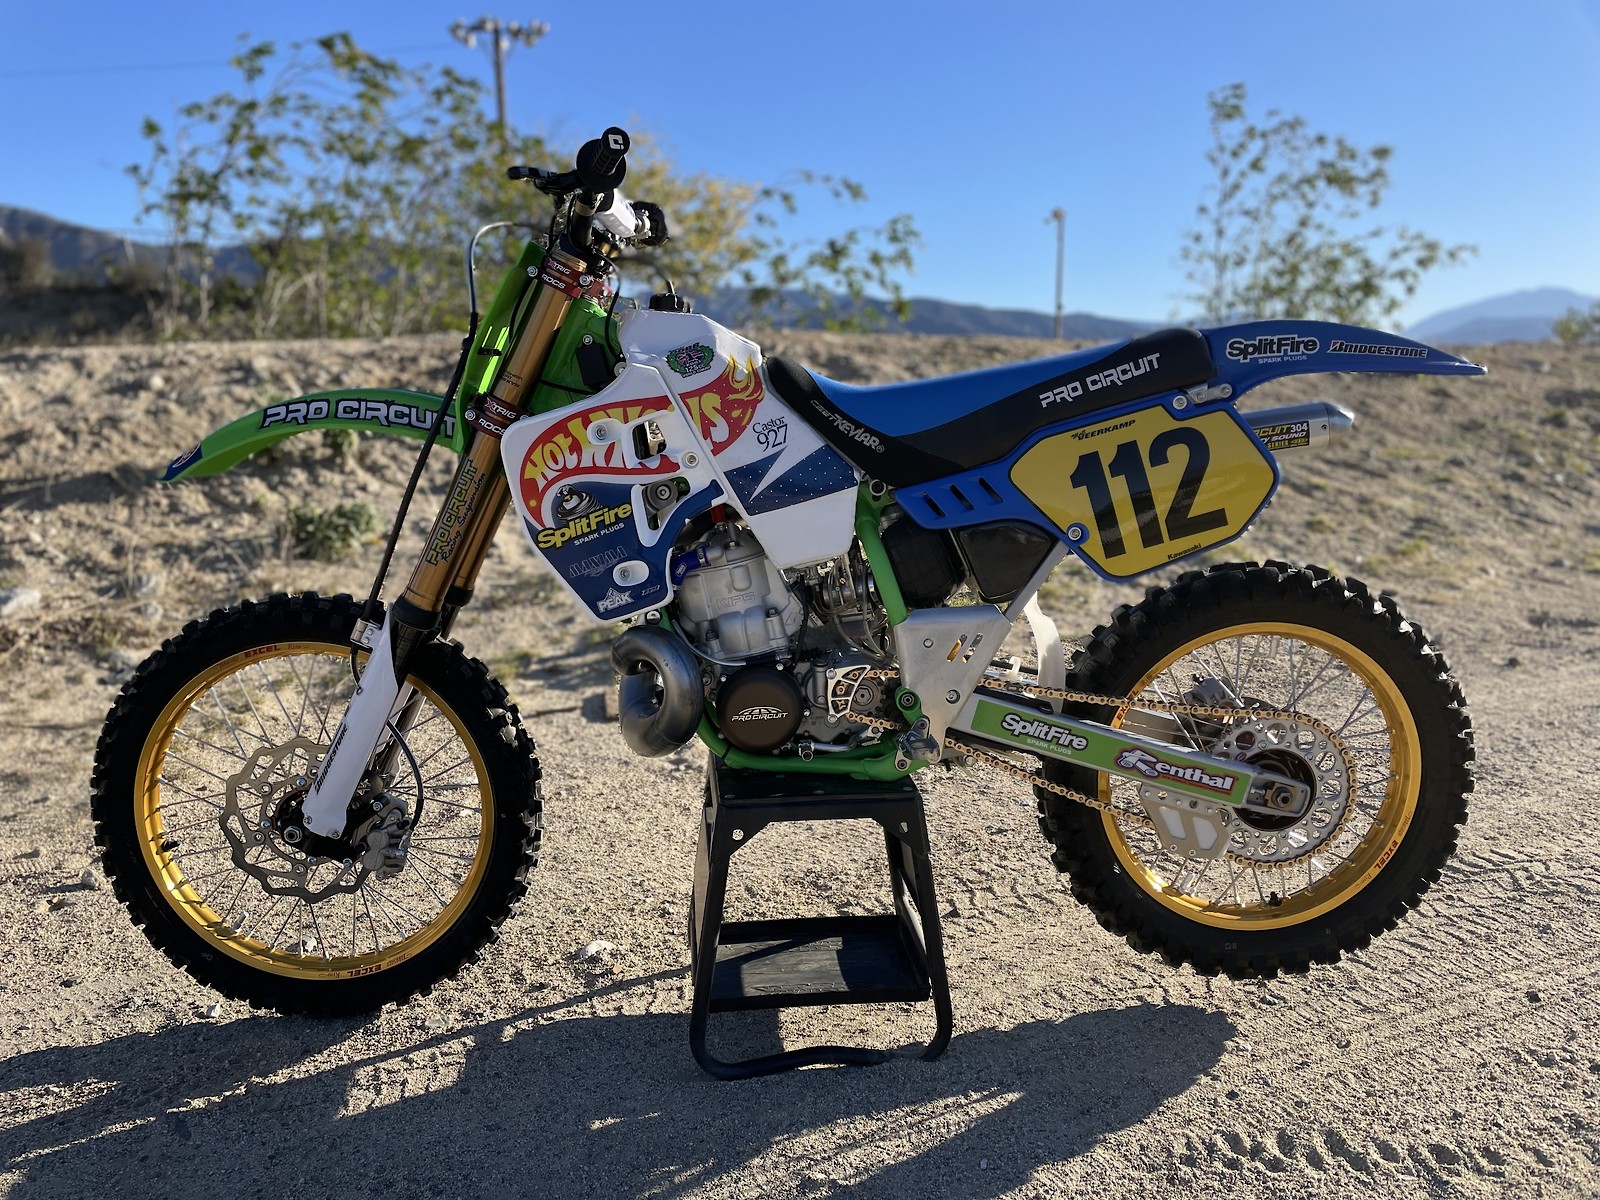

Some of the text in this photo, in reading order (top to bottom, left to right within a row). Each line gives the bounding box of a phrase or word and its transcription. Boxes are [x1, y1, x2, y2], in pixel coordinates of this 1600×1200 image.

[548, 258, 571, 275] XTRIG
[541, 274, 566, 289] ROCS
[1227, 336, 1318, 361] SplitFire
[1328, 340, 1428, 358] BRIDGESTONE
[1039, 352, 1160, 408] PRO CIRCUIT
[260, 399, 329, 428] PRO
[485, 397, 517, 419] XTRIG
[753, 416, 786, 434] Castor
[1290, 422, 1308, 433] 304
[757, 424, 788, 452] 927
[1070, 427, 1228, 559] 112
[425, 459, 478, 566] PRO CIRCUIT
[440, 473, 486, 562] Racing Suspension
[537, 503, 632, 549] SplitFire
[573, 522, 626, 547] SPARK PLUGS
[1167, 543, 1202, 560] Kawasaki
[597, 590, 635, 613] PEAK
[716, 591, 755, 609] KIPS
[244, 644, 281, 658] EXCEL
[1001, 713, 1088, 751] SplitFire
[1026, 738, 1072, 755] SPARK PLUGS
[1116, 747, 1236, 792] Renthal
[1373, 839, 1399, 870] EXCEL
[347, 963, 382, 978] EXCEL
